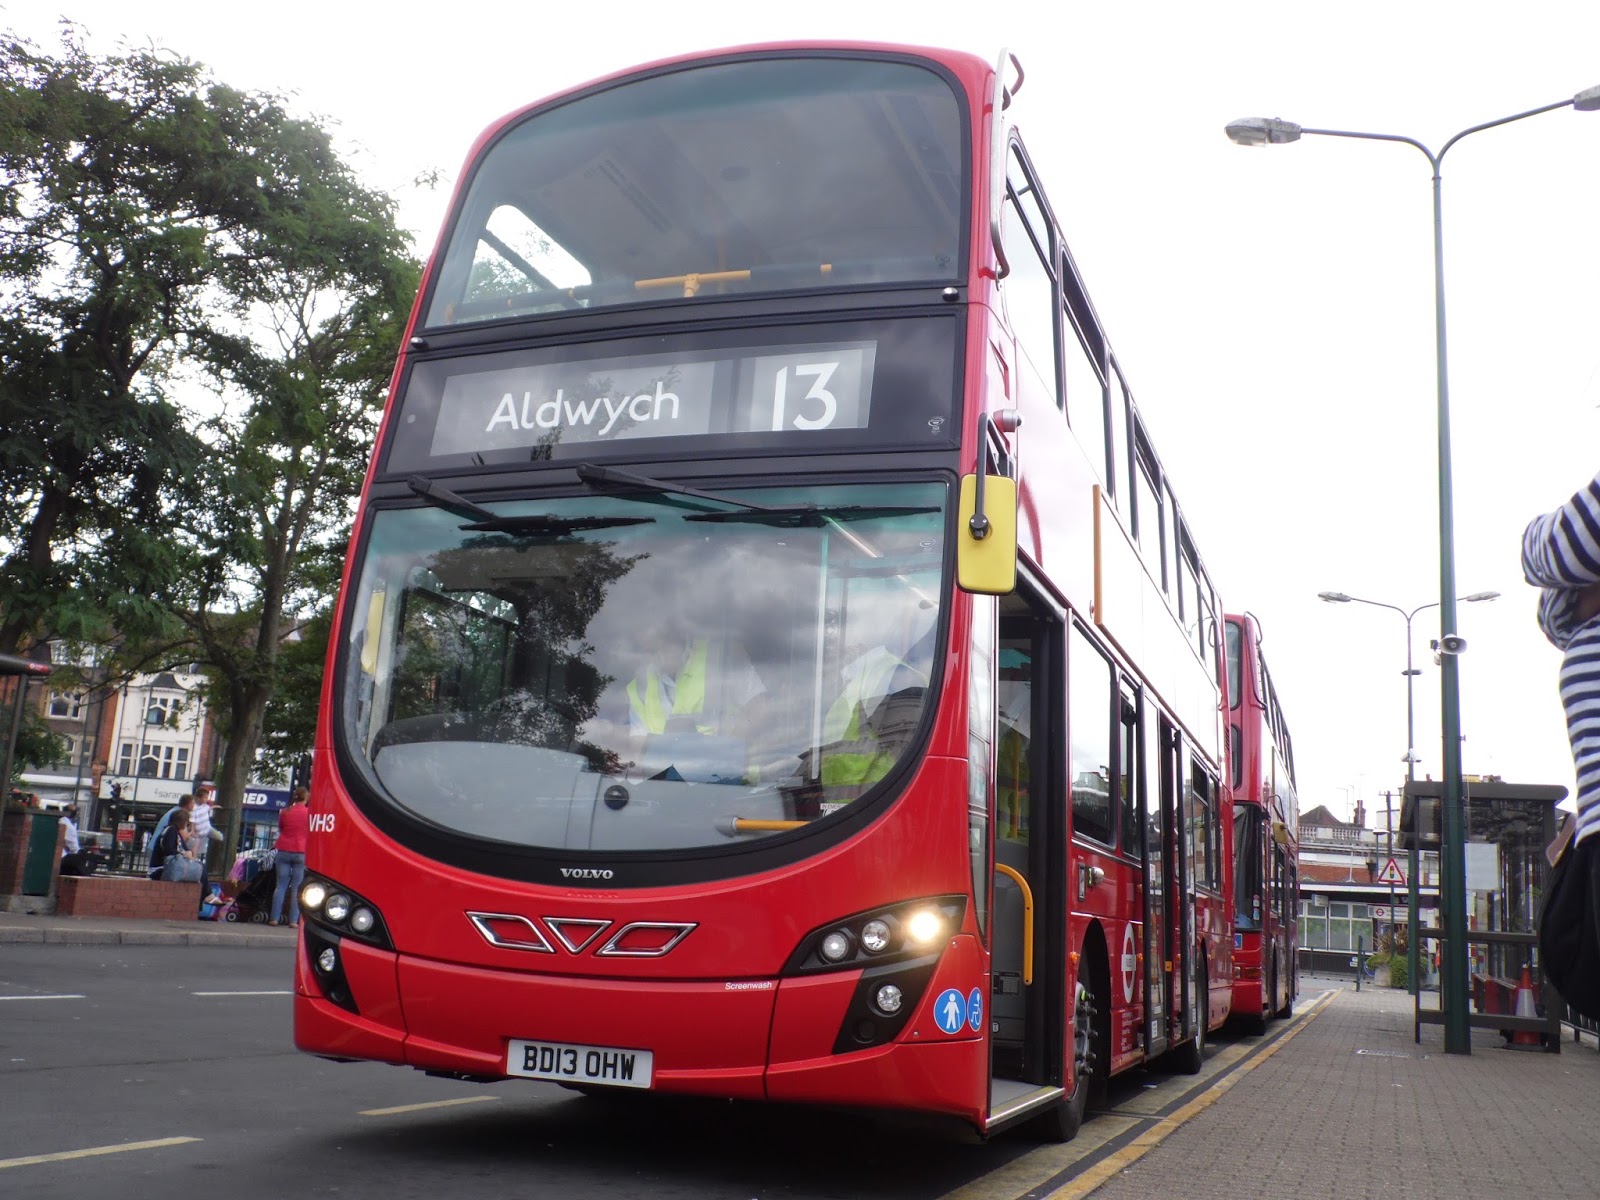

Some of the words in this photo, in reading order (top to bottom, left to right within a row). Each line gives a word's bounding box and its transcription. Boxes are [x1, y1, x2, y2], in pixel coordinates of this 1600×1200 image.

[485, 381, 680, 436] Aldwych
[771, 362, 840, 431] 13
[309, 813, 336, 833] VH3
[560, 868, 614, 880] VOLVO
[725, 981, 772, 991] Screenwash
[522, 1045, 578, 1075] BD13
[585, 1051, 636, 1081] OHW
